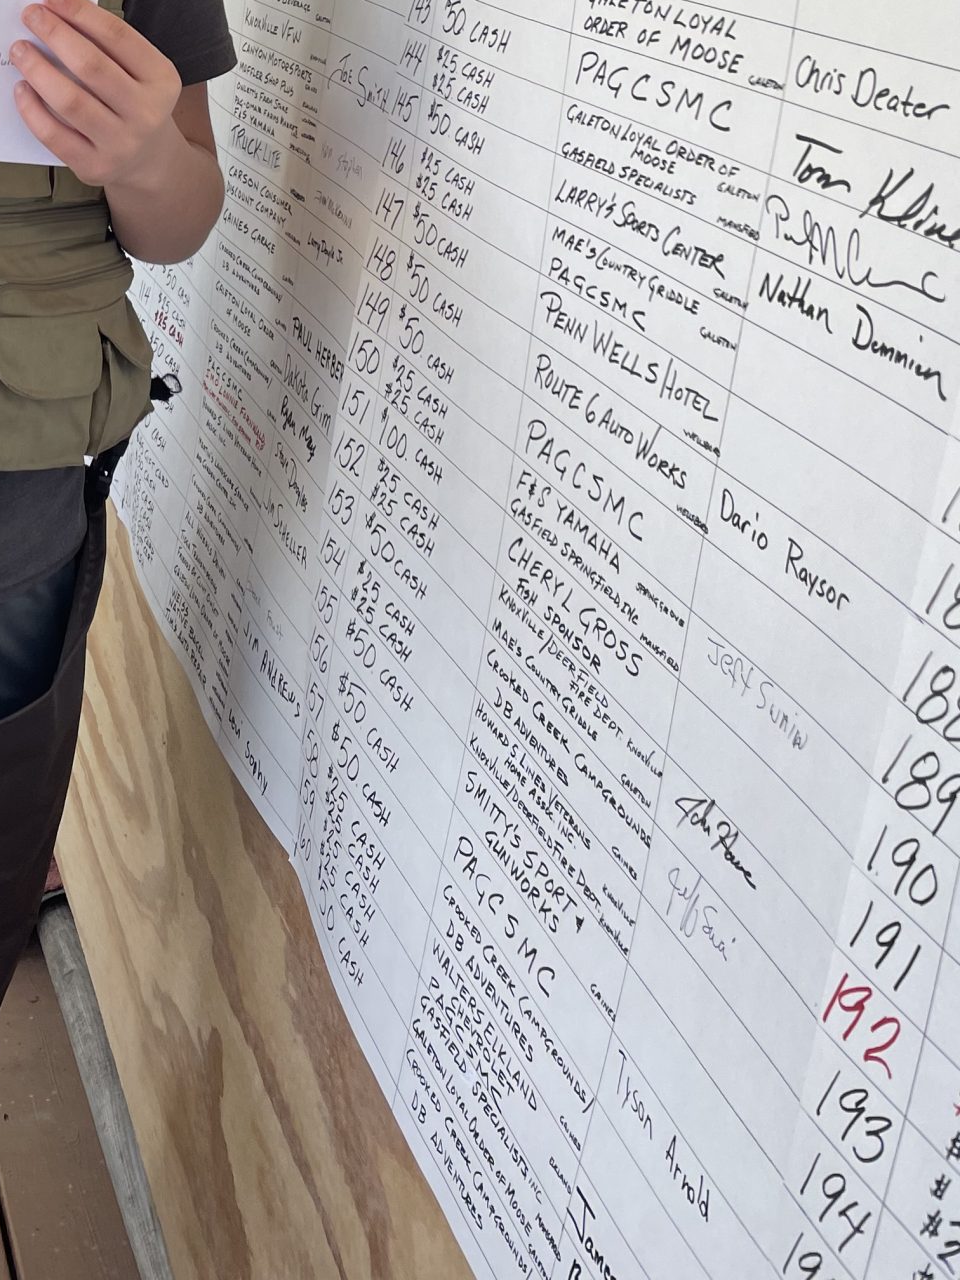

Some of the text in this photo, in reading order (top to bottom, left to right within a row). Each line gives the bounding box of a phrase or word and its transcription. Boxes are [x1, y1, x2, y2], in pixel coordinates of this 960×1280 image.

[584, 16, 744, 75] ORDER OF MOOSE
[673, 10, 737, 40] LOYAL
[795, 55, 950, 119] Chris Deater
[793, 133, 851, 193] Tom
[612, 201, 660, 242] SPORTS
[662, 226, 726, 280] CENTER
[293, 317, 345, 384] PAUL HERBER
[759, 273, 833, 334] Nathan
[348, 331, 380, 375] 150
[540, 291, 719, 423] PENN WELLS HOTEL
[534, 354, 688, 490] ROUTE 6 AUTO WORKS
[394, 560, 428, 600] CASH
[556, 502, 620, 575] YAMAHA
[719, 487, 850, 611] Dario Raysor
[508, 537, 643, 677] CHERYL GROSS
[882, 733, 960, 836] 189
[465, 771, 576, 911] SMITTY'S SPORT
[484, 831, 560, 935] GUNWORKS
[850, 900, 922, 992] 191
[432, 937, 537, 1112] WALTERS ELKLAND
[822, 973, 901, 1080] 192
[618, 1050, 710, 1222] Tyson Arnold
[816, 1070, 893, 1164] 193
[800, 1152, 872, 1253] 194
